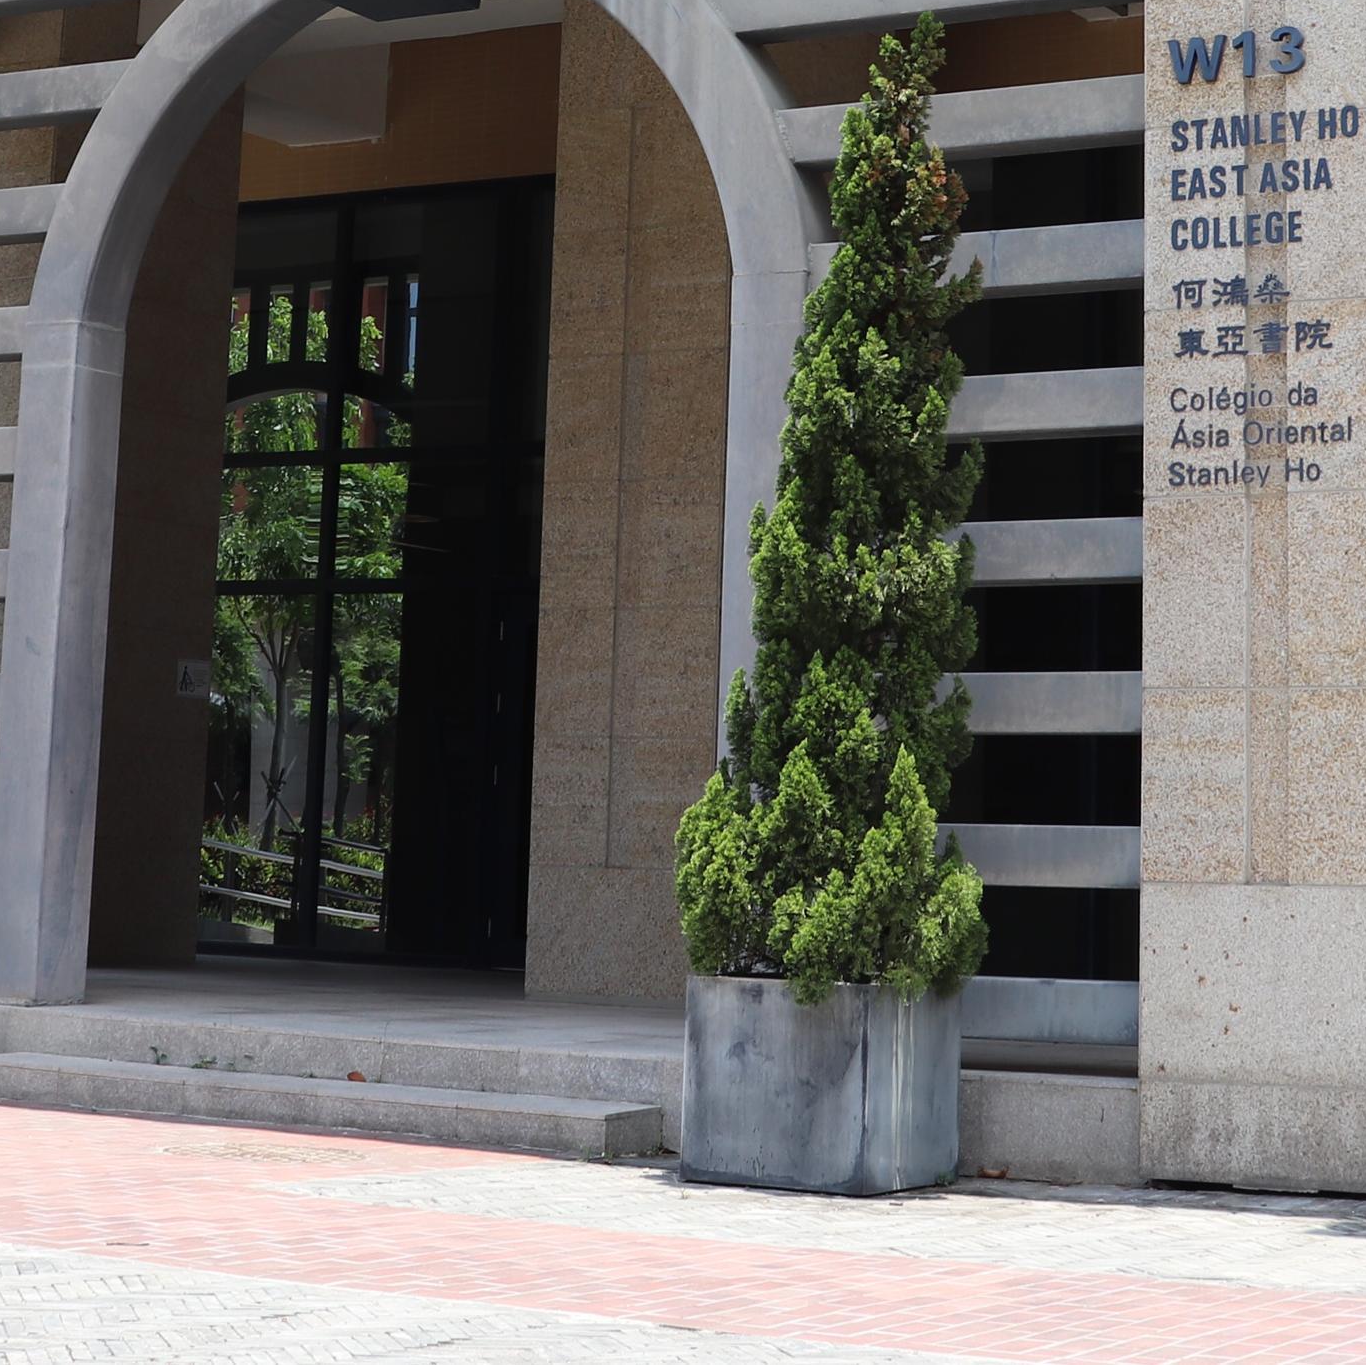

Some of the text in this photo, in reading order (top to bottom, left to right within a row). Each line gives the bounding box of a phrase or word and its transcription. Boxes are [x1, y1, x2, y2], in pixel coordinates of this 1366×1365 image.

[1166, 26, 1306, 84] W13
[1171, 105, 1360, 152] STANLEY HO
[1172, 158, 1333, 201] EAST ASIA
[1171, 211, 1302, 251] COLLEGE
[1172, 273, 1291, 310] 何鴻燊
[1174, 319, 1333, 358] 東亞書院
[1170, 381, 1318, 415] Colégio da
[1170, 416, 1353, 448] Ásia Oriental
[1168, 458, 1322, 487] Stanley Ho
